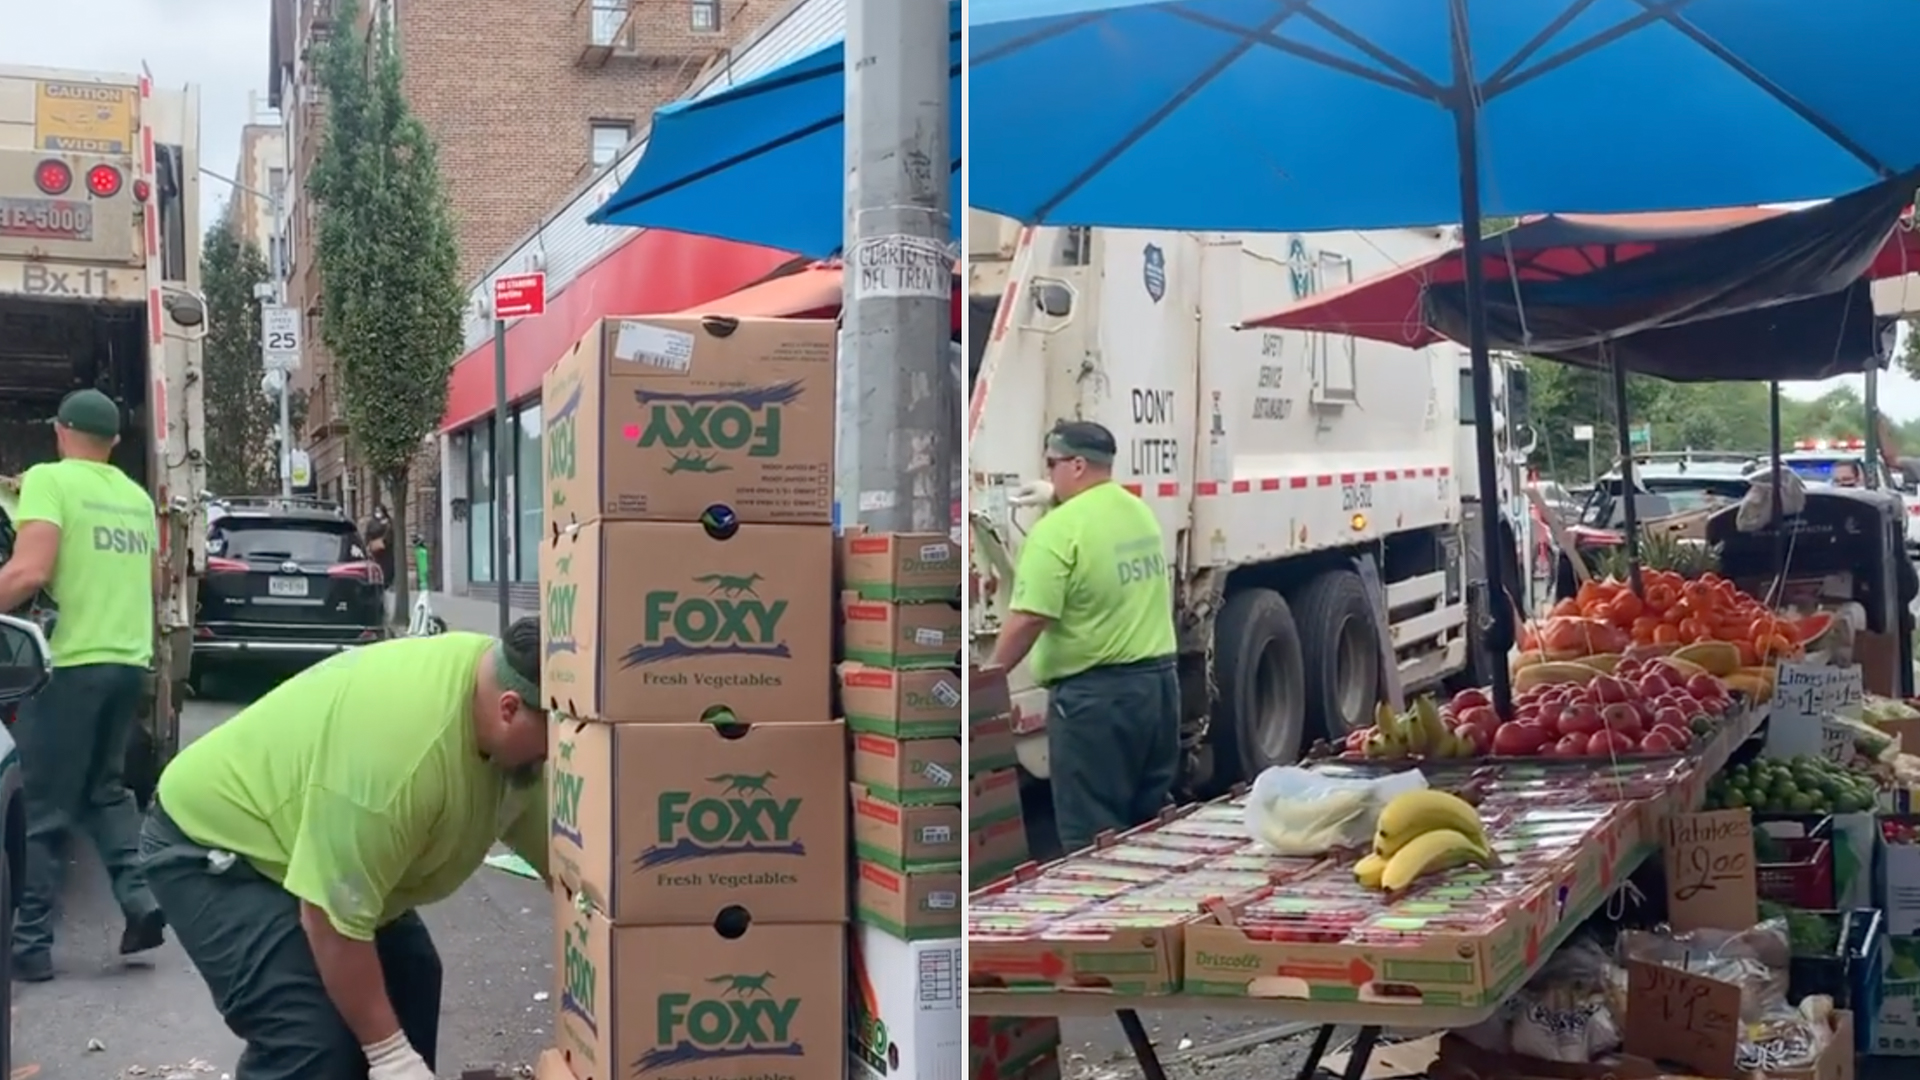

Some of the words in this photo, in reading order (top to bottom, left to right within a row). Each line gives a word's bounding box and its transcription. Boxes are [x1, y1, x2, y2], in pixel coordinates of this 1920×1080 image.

[46, 85, 121, 102] CAUTION
[23, 263, 108, 295] Bx.11
[862, 267, 888, 290] DEL
[896, 266, 934, 290] TREN
[269, 332, 297, 349] 25
[1132, 388, 1175, 424] DON'T
[637, 404, 781, 457] FOXY
[1131, 438, 1179, 476] LITTER
[645, 590, 789, 643] FOXY
[643, 671, 688, 686] Fresh
[693, 671, 783, 688] Vegetables
[657, 791, 803, 844] FOXY
[656, 871, 702, 887] Fresh
[708, 871, 798, 889] Vegetables
[656, 992, 802, 1046] FOXY
